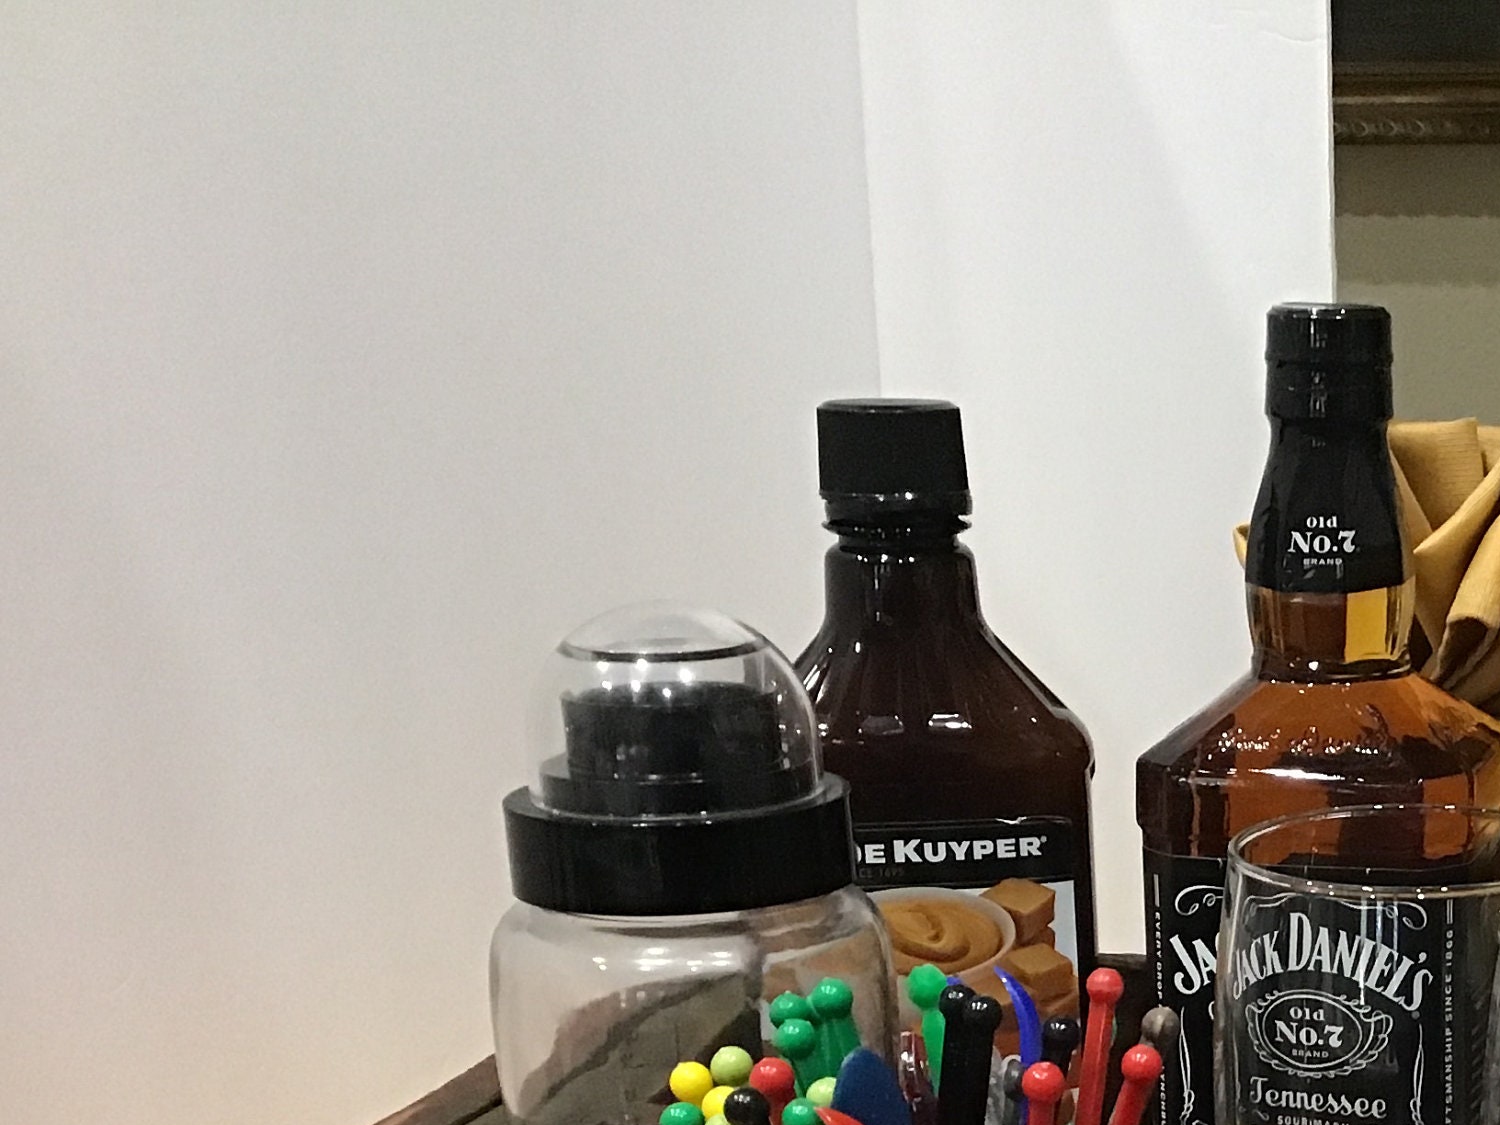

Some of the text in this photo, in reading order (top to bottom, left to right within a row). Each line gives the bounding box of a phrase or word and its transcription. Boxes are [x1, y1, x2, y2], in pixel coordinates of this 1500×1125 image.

[1306, 515, 1338, 529] Old
[1287, 529, 1356, 554] No.7
[1303, 557, 1343, 566] BRAND
[893, 836, 1042, 864] KUYPER
[1233, 911, 1434, 1012] JACK DANIEL'S
[1289, 1006, 1326, 1021] Old
[1274, 1019, 1345, 1048] No.7
[1291, 1048, 1329, 1058] BRAND
[1249, 1075, 1388, 1119] Tennessee
